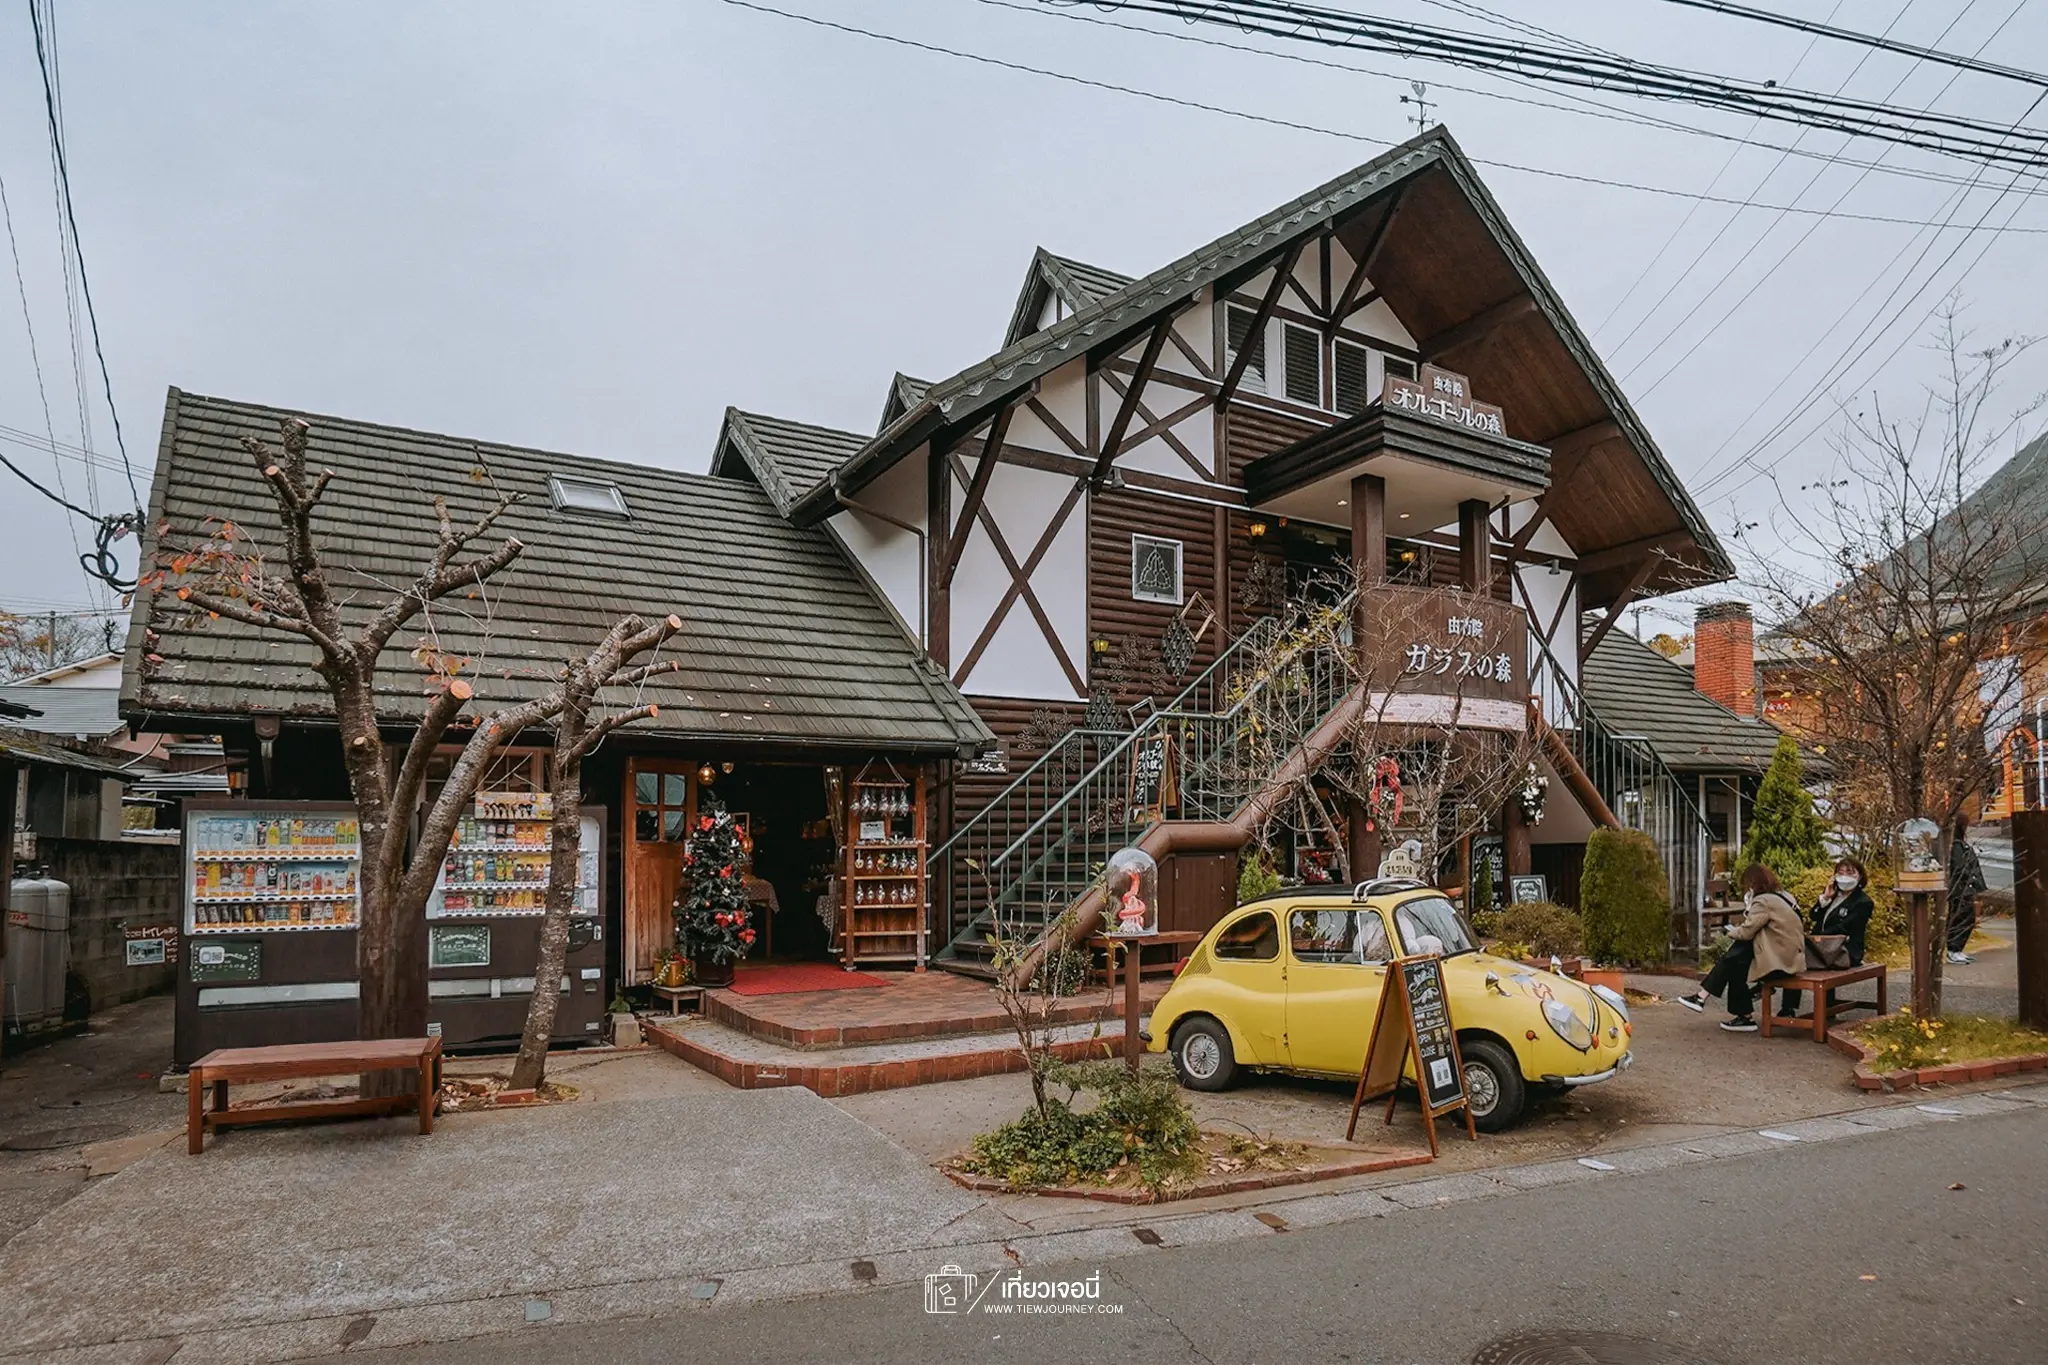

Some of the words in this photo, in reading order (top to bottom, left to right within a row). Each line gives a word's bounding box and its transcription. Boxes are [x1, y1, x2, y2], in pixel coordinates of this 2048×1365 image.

[1391, 387, 1502, 435] オルゴールの森
[1405, 644, 1512, 683] ガラスの森
